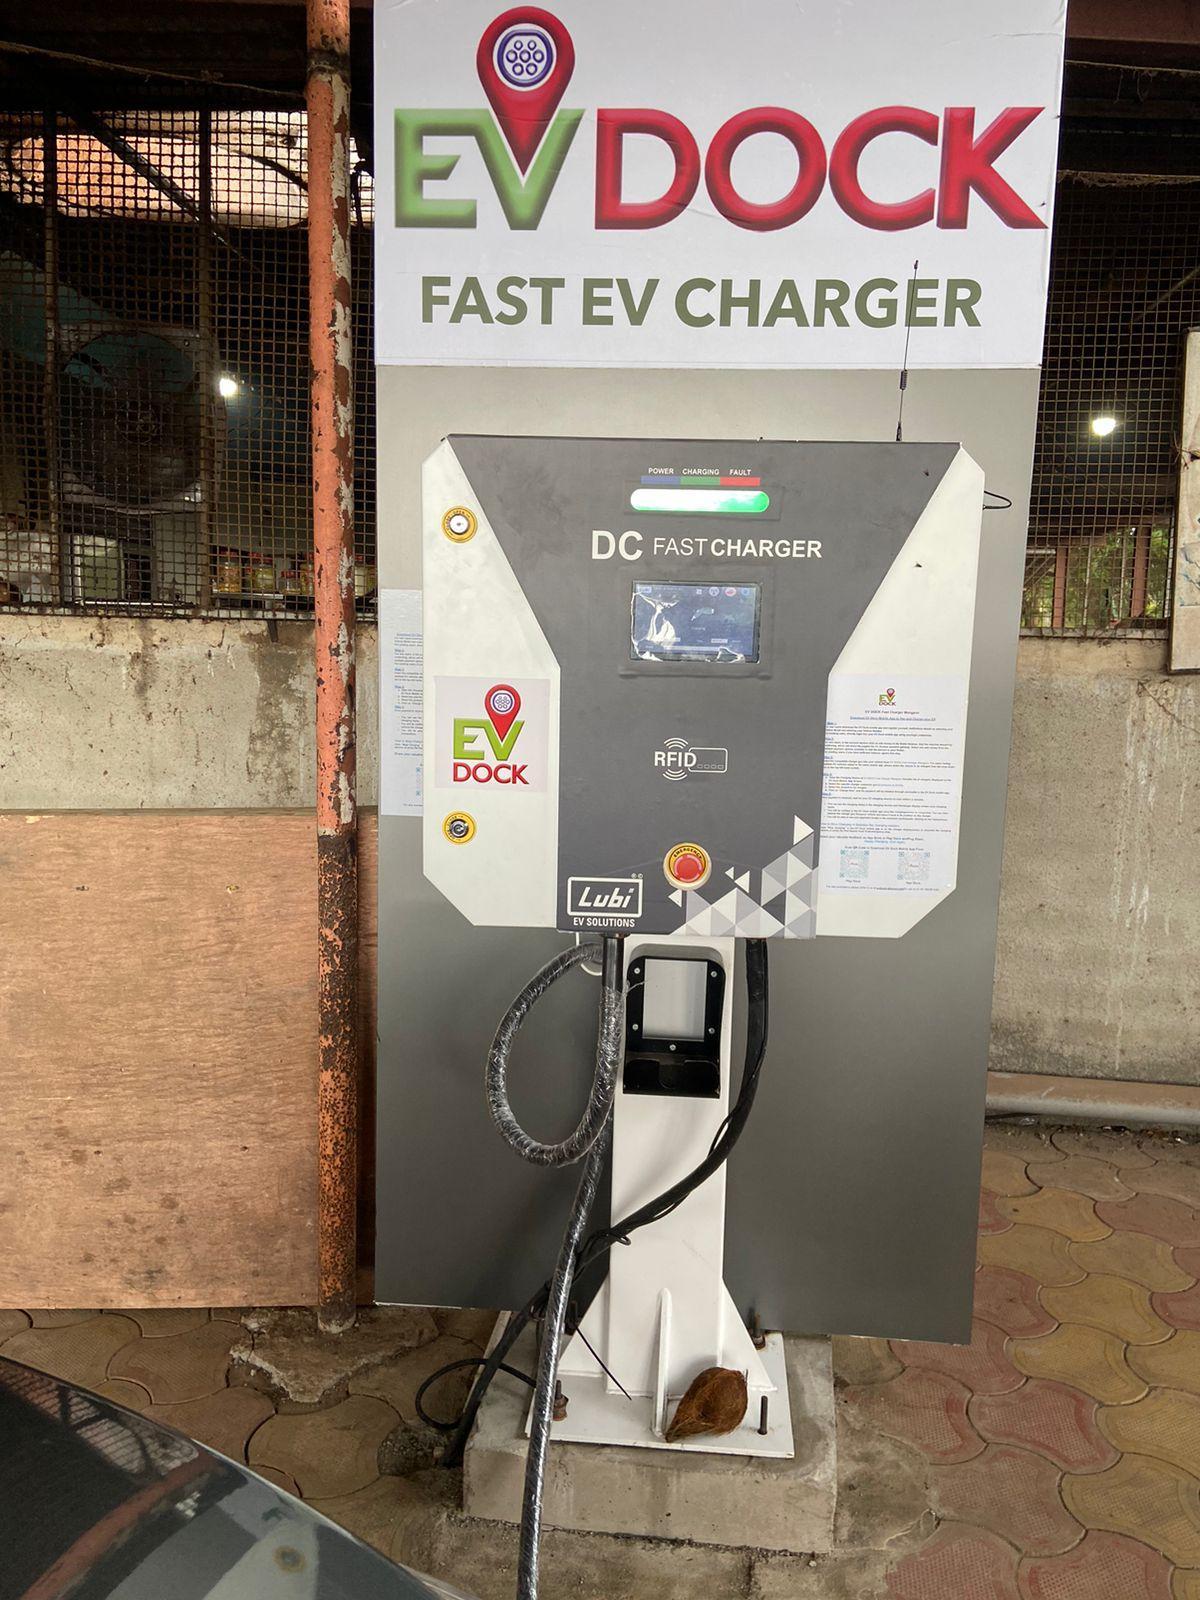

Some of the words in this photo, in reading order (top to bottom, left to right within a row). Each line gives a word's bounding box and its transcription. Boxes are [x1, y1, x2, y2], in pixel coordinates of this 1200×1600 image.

[394, 107, 585, 231] EV
[595, 105, 1049, 232] DOCK
[420, 275, 565, 325] FAST
[581, 278, 660, 327] EV
[674, 278, 982, 328] CHARGER
[648, 467, 674, 475] POWER
[682, 468, 720, 476] CHARGING
[591, 529, 643, 561] DC
[653, 538, 708, 555] FAST
[710, 538, 823, 558] CHARGER
[453, 718, 525, 762] EV
[654, 751, 697, 769] RFID
[453, 762, 530, 786] DOCK
[578, 886, 635, 908] Lubi
[573, 917, 585, 926] EV
[586, 917, 636, 928] SOLUTIONS
